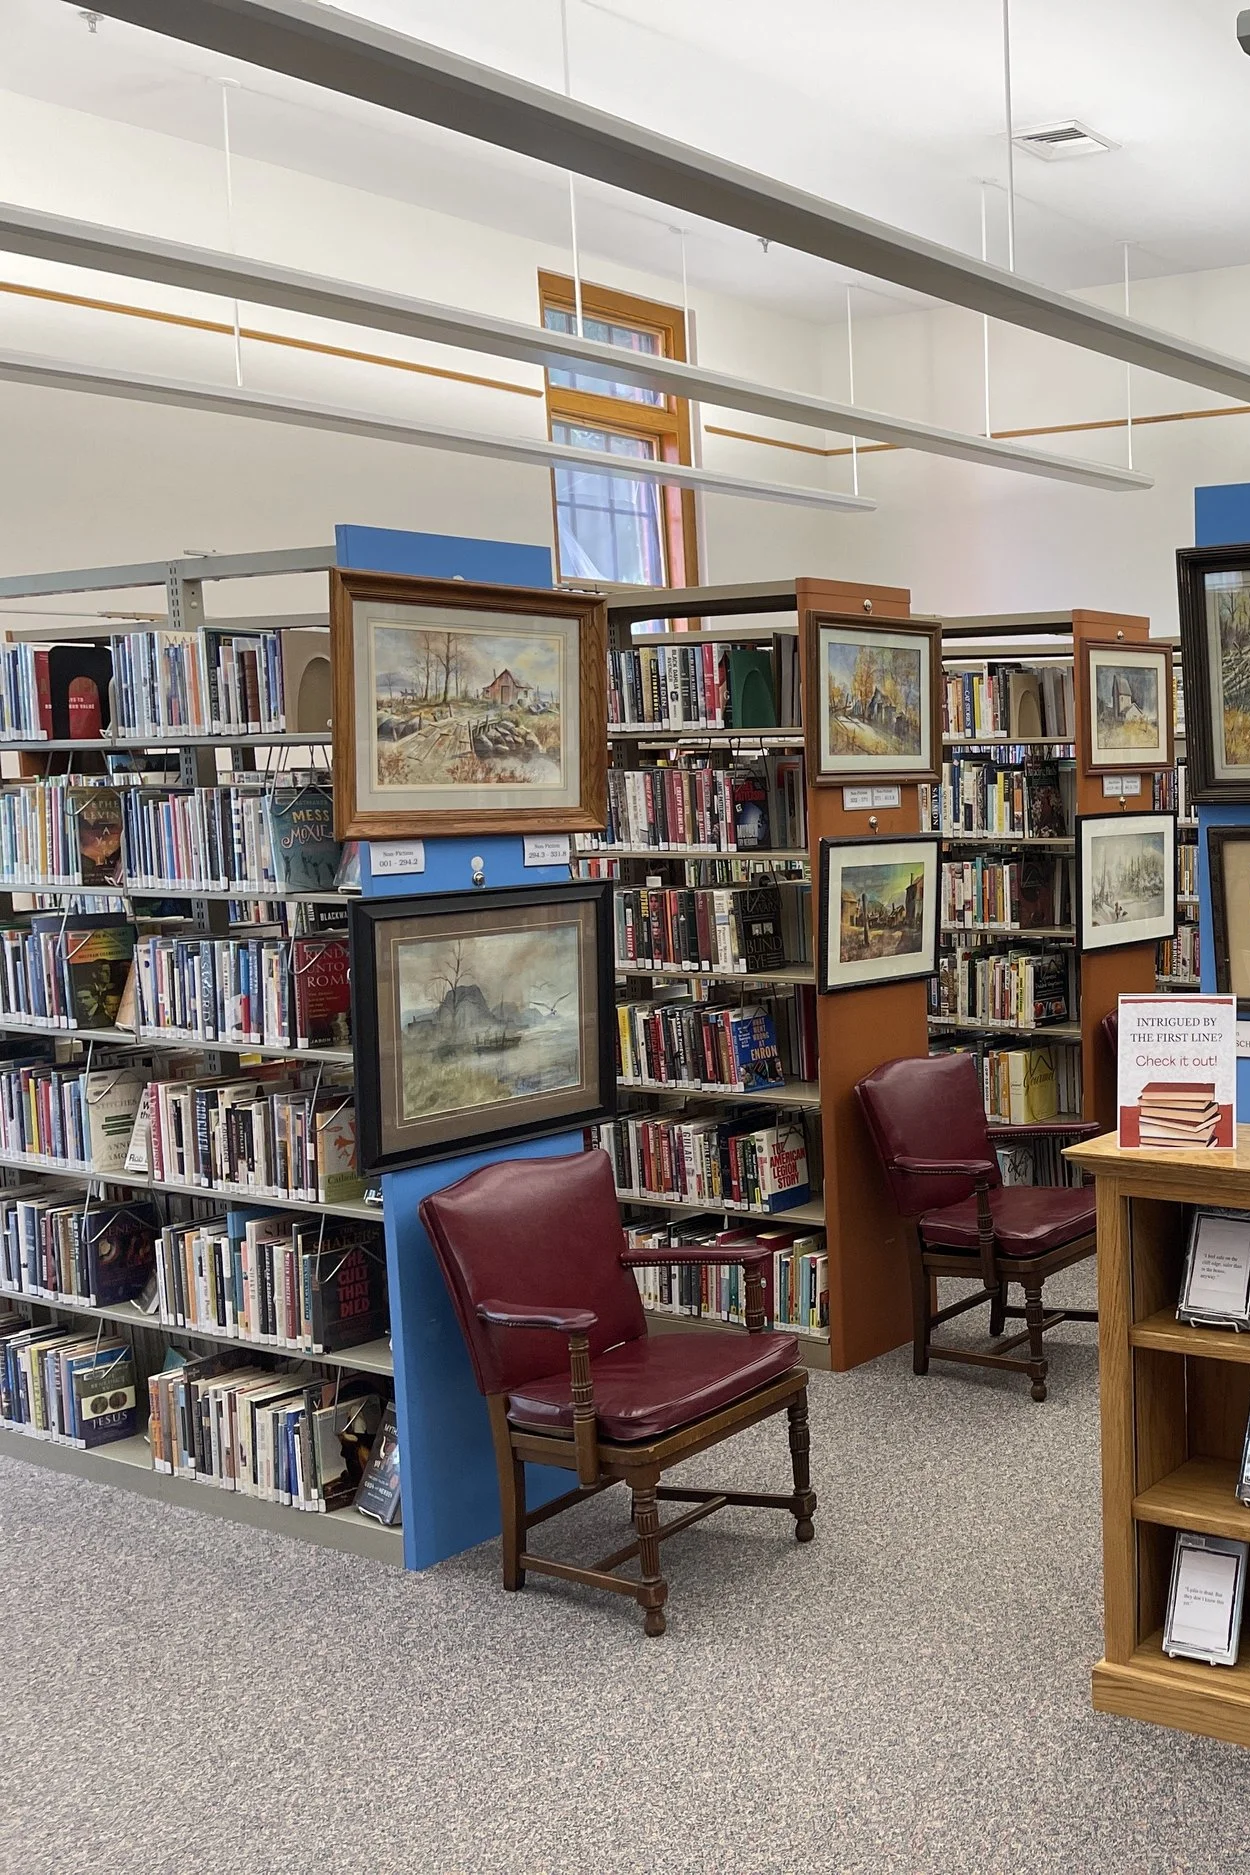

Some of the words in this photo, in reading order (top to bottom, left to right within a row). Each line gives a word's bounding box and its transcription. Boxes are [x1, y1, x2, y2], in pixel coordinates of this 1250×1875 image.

[675, 787, 683, 806] CREEPY
[292, 809, 330, 823] MESS
[717, 797, 725, 822] PATTERSON
[399, 858, 418, 866] 294.2
[640, 890, 649, 918] OUTRAGE
[746, 935, 783, 954] BLIND
[749, 953, 767, 970] EYE
[1137, 1017, 1200, 1027] INTRIGUED
[1203, 1018, 1217, 1027] BY
[1130, 1033, 1154, 1043] THE
[1157, 1033, 1188, 1042] FIRST
[1191, 1033, 1223, 1042] LINE?
[750, 1045, 778, 1059] ENRON
[1136, 1055, 1176, 1067] Check
[1180, 1056, 1189, 1067] it
[1192, 1055, 1217, 1067] out!
[683, 1131, 693, 1162] GULAG
[770, 1147, 806, 1169] AMERICAN
[773, 1162, 798, 1179] LEGION
[778, 1172, 800, 1190] STORY
[338, 1283, 369, 1299] THAT
[340, 1298, 369, 1317] DIED
[93, 1411, 128, 1430] JESUS
